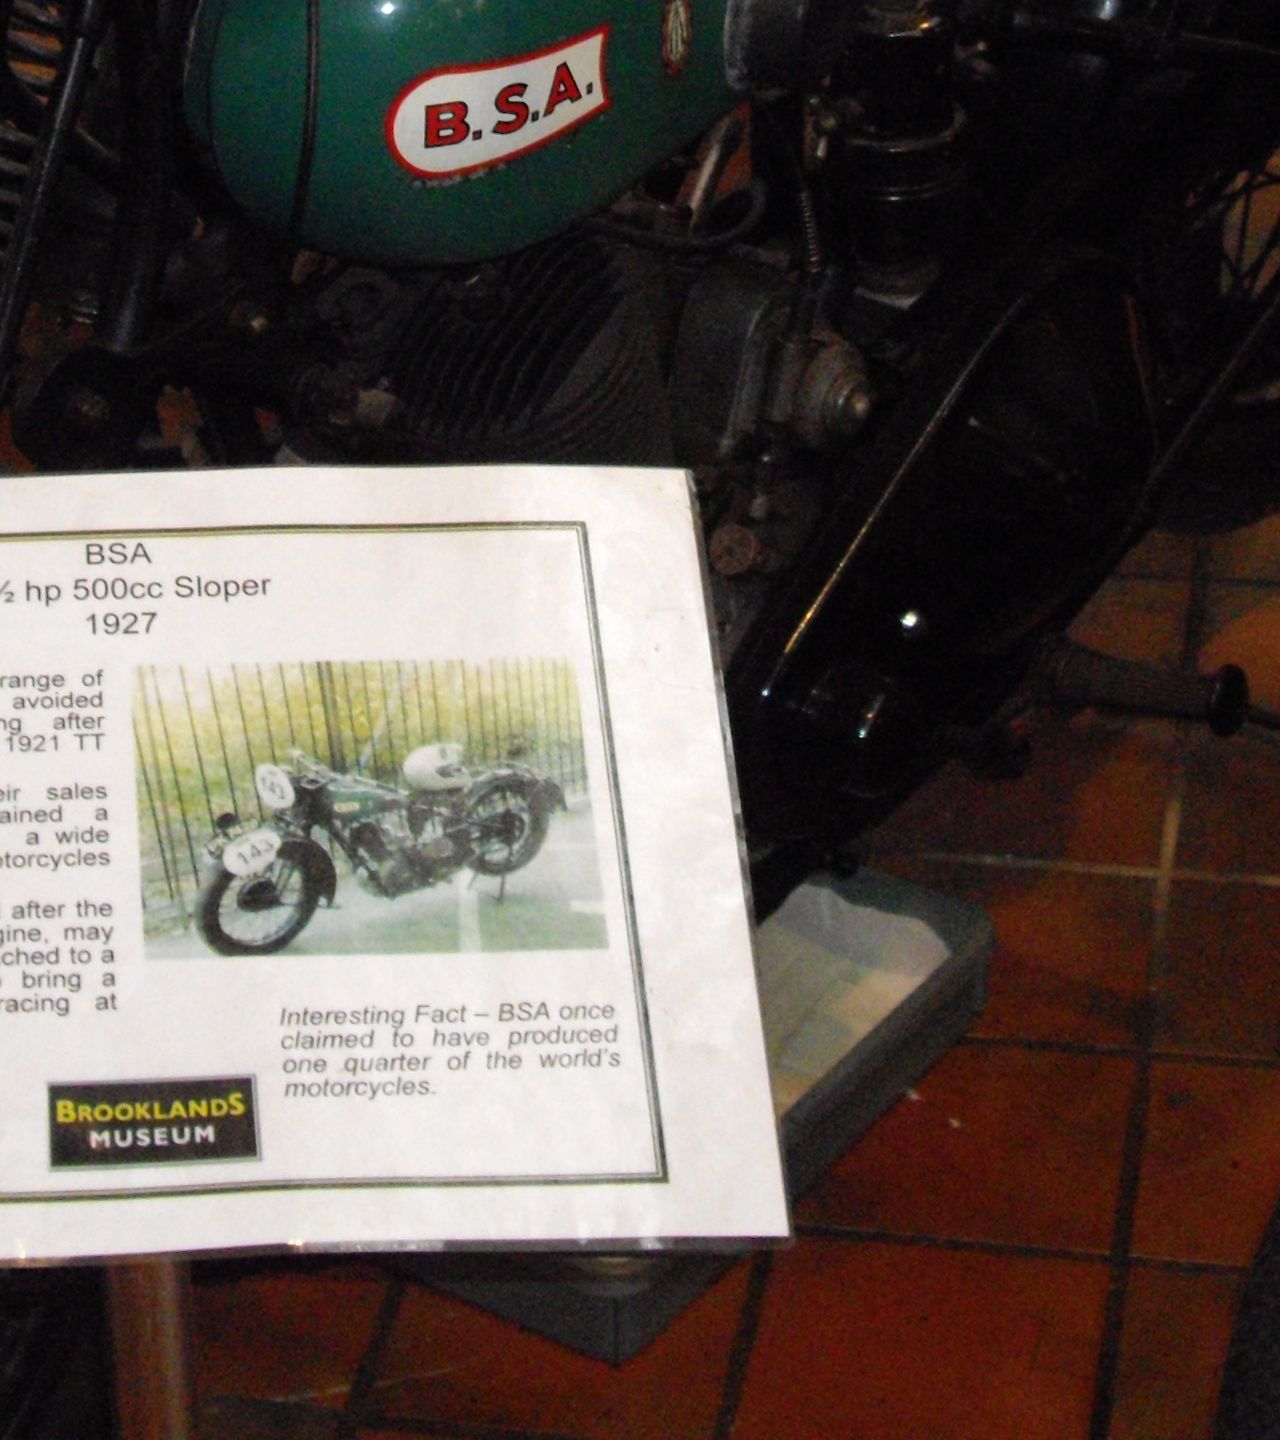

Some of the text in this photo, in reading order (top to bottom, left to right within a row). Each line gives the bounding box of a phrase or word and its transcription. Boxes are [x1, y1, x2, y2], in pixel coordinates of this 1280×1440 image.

[424, 62, 594, 149] B.S.A.
[85, 542, 153, 565] BSA
[24, 579, 63, 608] hp
[73, 577, 164, 601] 500cc
[174, 575, 272, 603] Sloper
[85, 610, 159, 636] 1927
[0, 674, 66, 693] range
[80, 669, 105, 687] of
[12, 690, 104, 709] avoided
[52, 711, 106, 730] after
[4, 733, 59, 753] 1921
[73, 733, 106, 752] TT
[11, 899, 67, 919] after
[74, 898, 114, 918] the
[63, 926, 115, 947] may
[68, 946, 93, 965] to
[100, 949, 117, 964] a
[279, 1001, 616, 1031] Interesting Fact BSA once
[280, 1024, 620, 1050] claimed to have produced
[281, 1057, 328, 1074] one
[339, 1053, 432, 1078] quarter
[446, 1049, 472, 1071] of
[485, 1048, 523, 1070] the
[284, 1076, 435, 1101] motorcycles.
[56, 1092, 245, 1123] BROOKLANDS
[89, 1125, 215, 1149] MUSEUM
